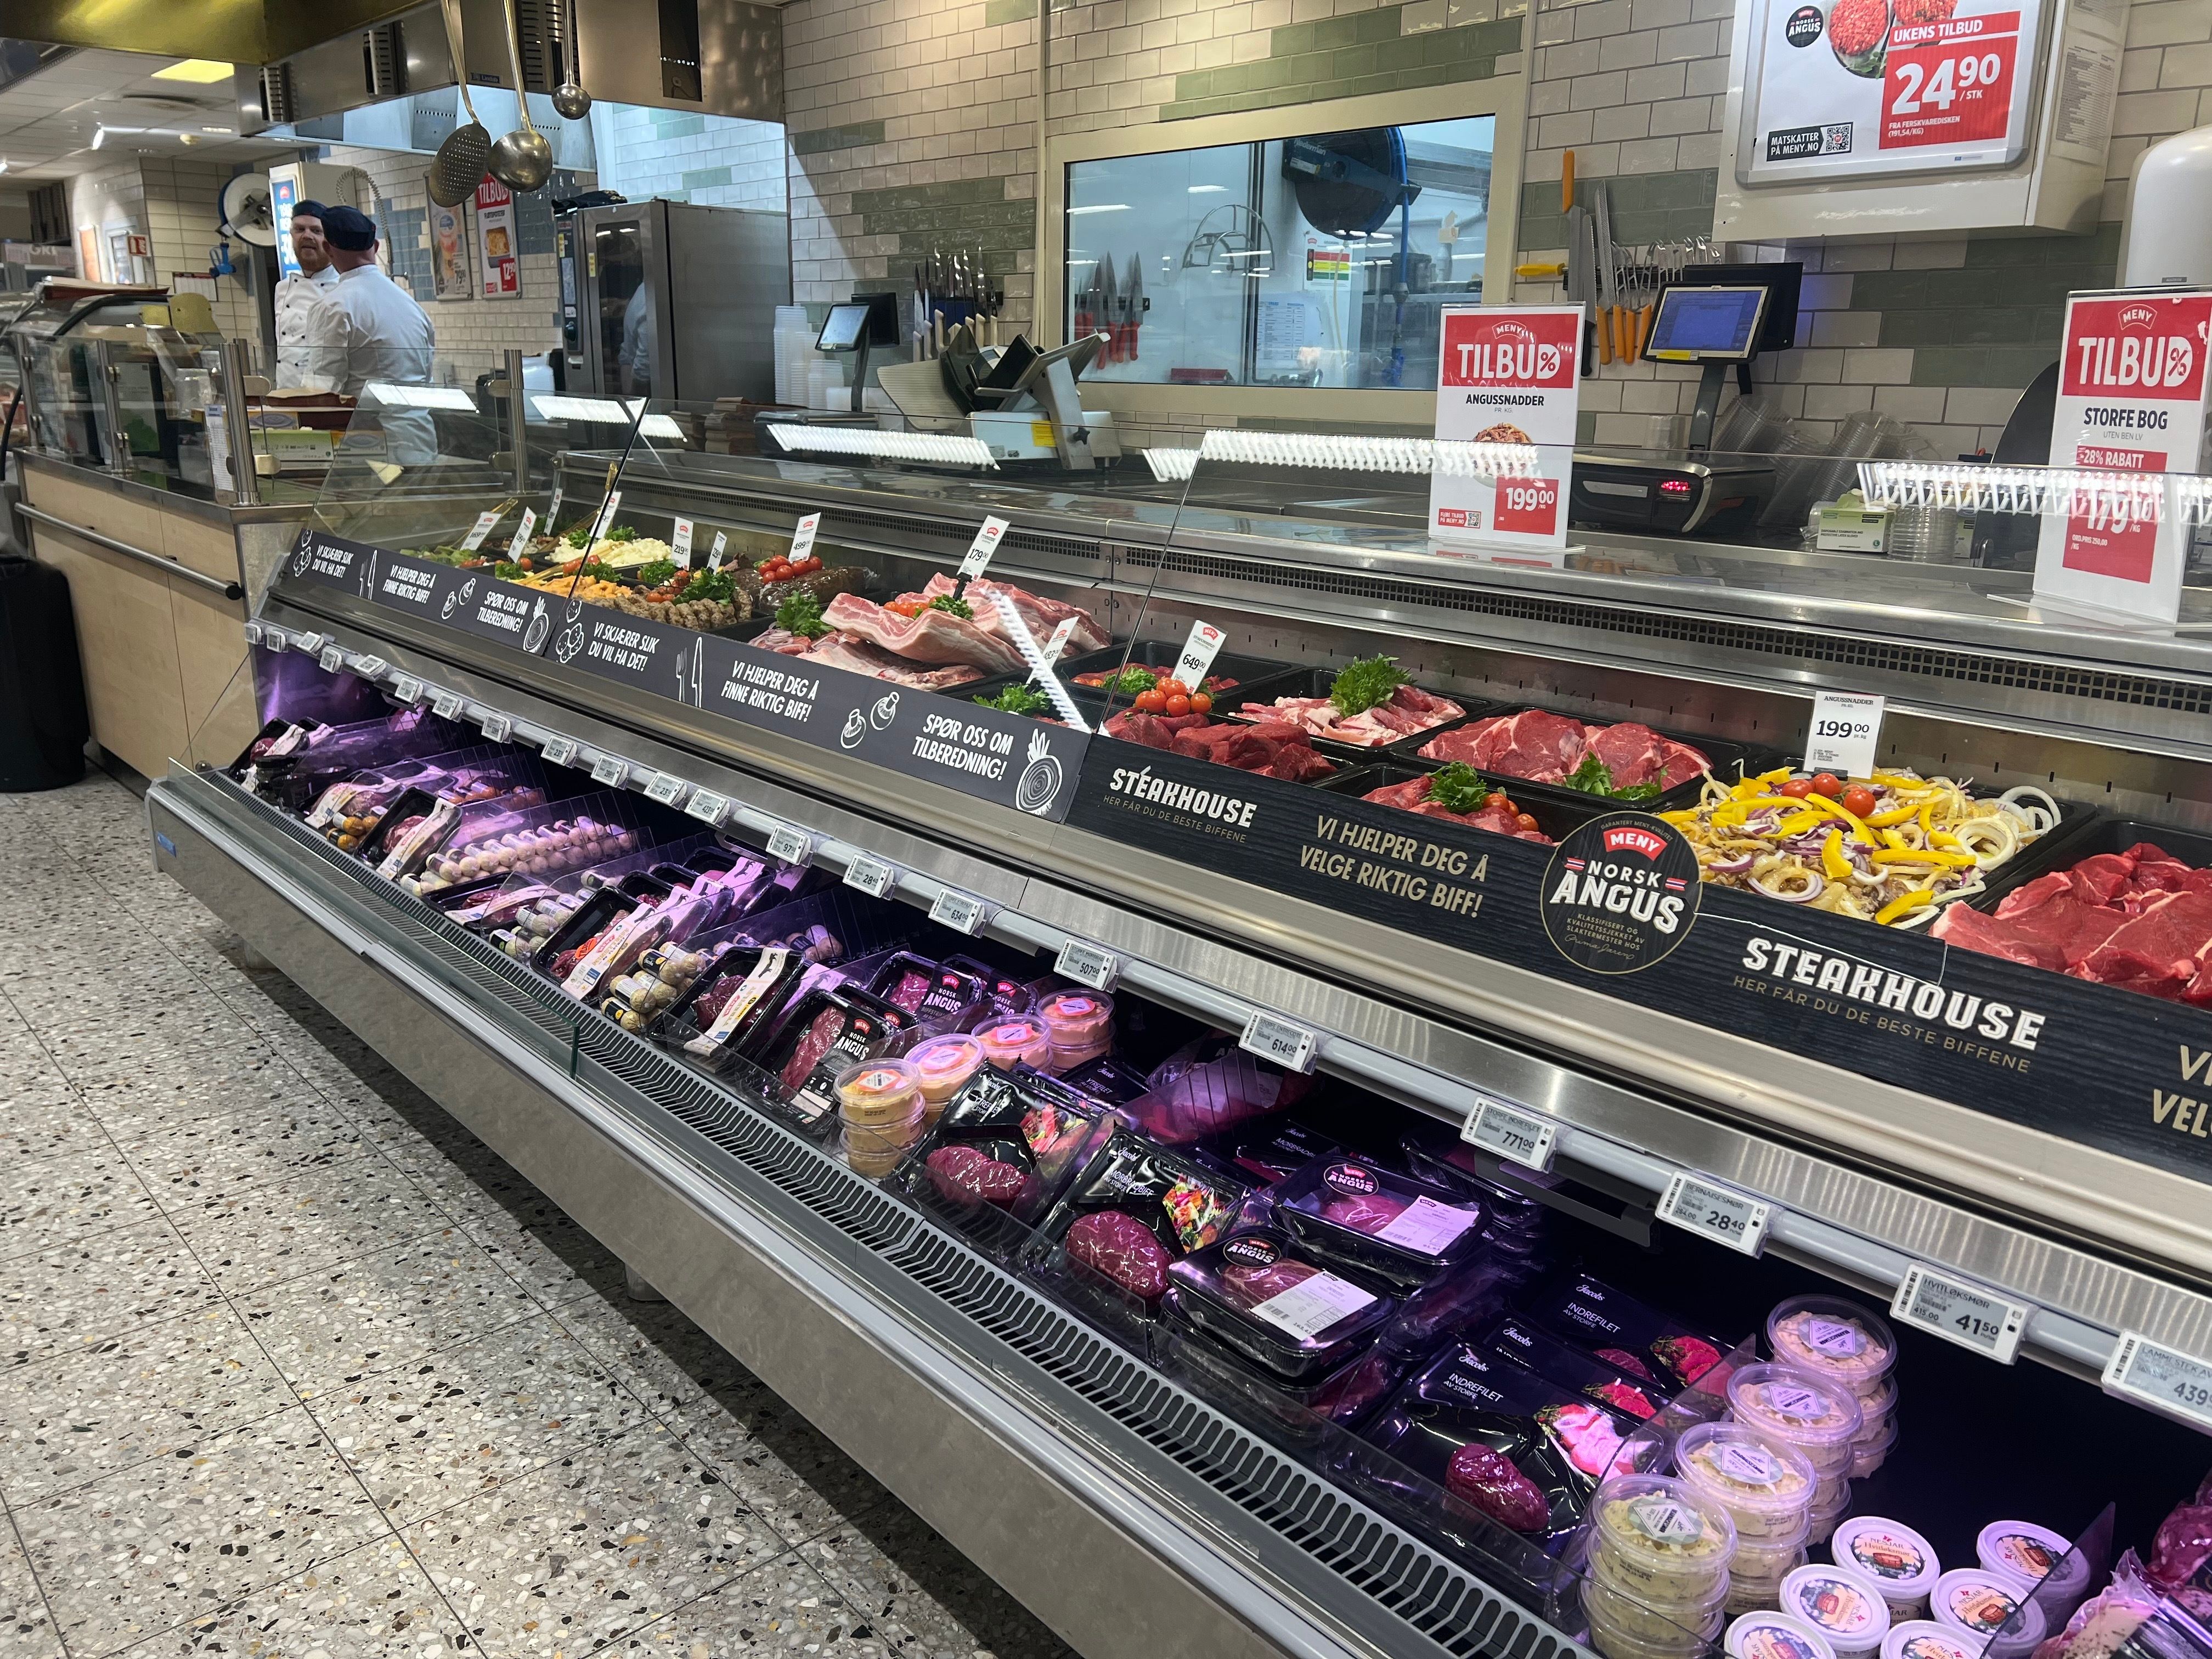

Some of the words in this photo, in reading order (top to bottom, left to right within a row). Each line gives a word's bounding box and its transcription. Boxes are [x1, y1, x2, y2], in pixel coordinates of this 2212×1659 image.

[1788, 22, 1821, 37] ANGUS
[1894, 25, 1936, 42] UKENS
[1938, 20, 1983, 37] TILBUD
[1966, 89, 1983, 99] STK
[1889, 121, 1901, 129] FRA
[1902, 115, 1960, 127] FERSKVAREDISKEN
[1294, 138, 1326, 156] Nederman
[1770, 132, 1819, 145] MATSKATTER
[1770, 145, 1781, 156] PÅ
[1782, 142, 1819, 154] MENY.NO
[2123, 309, 2153, 323] MENY
[1496, 324, 1523, 334] MENY
[1465, 394, 1545, 407] ANGUSSNADDER
[2084, 407, 2135, 428] STORFE
[2137, 409, 2168, 431] BOG
[2103, 430, 2119, 440] UTEN
[2121, 431, 2134, 440] BEN
[2135, 432, 2143, 441] LV
[2105, 451, 2145, 469] RABATT
[2129, 524, 2141, 533] /KG
[317, 544, 324, 556] VI
[341, 551, 353, 565] SLIK
[312, 560, 320, 571] DU
[319, 562, 328, 574] VIL
[328, 564, 335, 575] HA
[334, 566, 346, 579] DET!
[390, 565, 397, 577] VI
[396, 566, 417, 584] HJELPER
[417, 572, 430, 585] DEG
[430, 573, 437, 589] Å
[382, 578, 398, 594] FINNE
[397, 583, 416, 600] RIKTIG
[415, 587, 431, 604] BIFF!
[484, 591, 503, 606] SPØR
[503, 597, 516, 610] OSS
[515, 599, 529, 616] OM
[476, 606, 522, 634] TILBEREDNING!
[593, 622, 605, 637] VI
[603, 624, 639, 648] SKJÆRER
[639, 632, 660, 654] SLIK
[588, 640, 601, 657] DU
[602, 644, 615, 662] VIL
[616, 648, 628, 665] HA
[626, 652, 648, 672] DET!
[731, 660, 745, 678] VI
[744, 663, 785, 691] HJELPER
[784, 674, 807, 697] DEG
[808, 679, 820, 701] Å
[721, 680, 749, 704] FINNE
[750, 687, 786, 714] RIKTIG
[786, 697, 812, 723] BIFF!
[1824, 696, 1874, 705] ANGUSSNADDER
[922, 713, 961, 742] SPØR
[963, 724, 990, 748] OSS
[989, 730, 1014, 756] OM
[911, 736, 1008, 782] TILBEREDNING!
[1103, 794, 1121, 806] HER
[1122, 797, 1142, 812] FÅR
[1143, 804, 1156, 816] DU
[1158, 809, 1171, 821] DE
[1172, 813, 1203, 831] BESTE
[1204, 823, 1247, 844] BIFFENE
[1600, 820, 1634, 830] GARANTERT
[1317, 815, 1336, 842] VI
[1339, 823, 1419, 864] HJELPER
[1420, 843, 1469, 876] DEG
[1470, 854, 1489, 883] Å
[1610, 833, 1661, 853] MENY
[1300, 845, 1355, 881] VELGE
[1357, 861, 1429, 902] RIKTIG
[1430, 882, 1484, 919] BIFF!
[1588, 860, 1662, 888] NORSK
[1549, 870, 1685, 934] ANGUS
[1566, 917, 1633, 941] KVALITETSSJEKKET
[1634, 935, 1645, 944] AV
[1577, 913, 1625, 931] KLASSIFISERT
[1626, 927, 1638, 935] OG
[1566, 925, 1623, 946] SLAKTERMESTER
[1624, 941, 1641, 951] HOS
[938, 988, 957, 998] NORSK
[1742, 937, 2046, 1051] STEAKHOUSE
[923, 992, 962, 1015] ANGUS
[855, 1021, 870, 1032] MENY
[1733, 975, 1767, 995] HER
[1772, 981, 1807, 1007] FÅR
[1814, 997, 1839, 1015] DU
[1845, 1007, 1870, 1025] DE
[1876, 1015, 1937, 1044] BESTE
[1943, 1035, 2032, 1074] BIFFENE
[849, 1032, 867, 1043] NORSK
[833, 1036, 870, 1061] ANGUS
[1118, 1147, 1137, 1162] Jacobs
[1328, 1175, 1374, 1193] ANGUS
[1339, 1174, 1365, 1184] NORSK
[1227, 1245, 1274, 1264] ANGUS
[1242, 1244, 1268, 1255] NORSK
[1576, 1284, 1605, 1302] Jacobs
[1923, 1278, 1990, 1309] HVITLØKSMØR
[1567, 1302, 1621, 1334] INDREFILET
[1572, 1313, 1596, 1329] STORFE
[1503, 1327, 1533, 1347] Jacobs
[1458, 1354, 1489, 1373] Jacobs
[1443, 1380, 1453, 1389] AV
[1452, 1384, 1478, 1401] STORFE
[1449, 1373, 1504, 1402] INDREFILET
[1864, 1542, 1911, 1557] Hvitløksmør
[1870, 1537, 1904, 1550] NESJAR
[1958, 1589, 1984, 1605] NESJAR
[1961, 1594, 1995, 1615] Hvitløksmør
[1846, 1604, 1862, 1627] NESJAR
